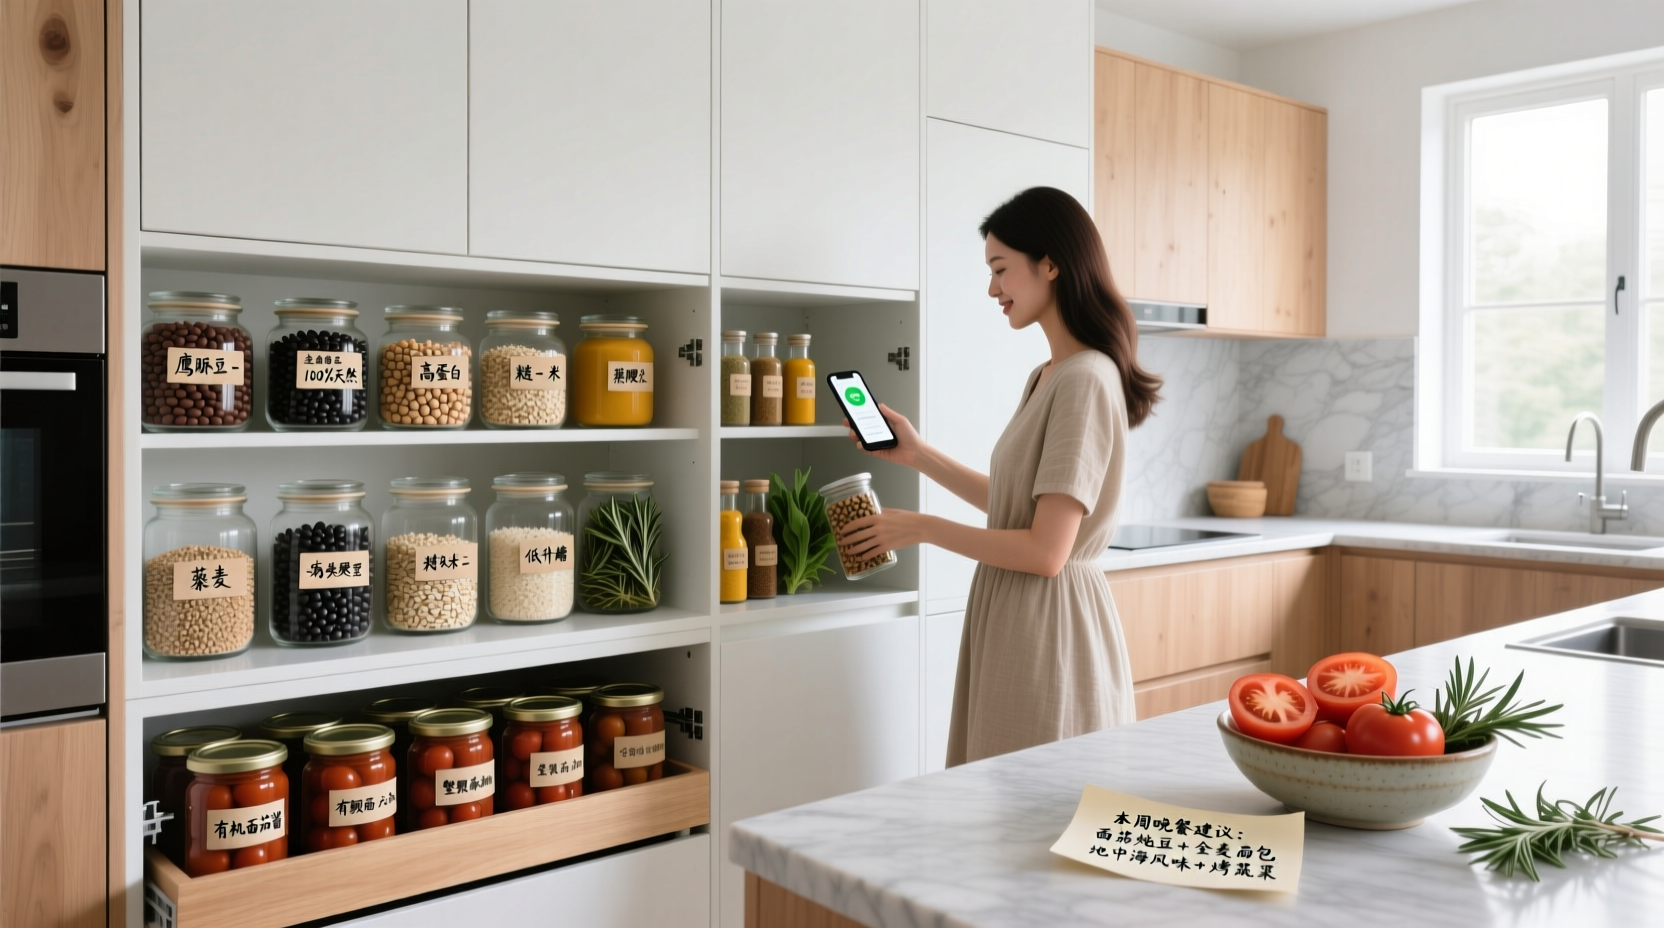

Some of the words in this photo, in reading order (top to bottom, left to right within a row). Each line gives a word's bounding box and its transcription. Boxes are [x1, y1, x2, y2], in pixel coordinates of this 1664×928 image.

[304, 367, 358, 384] 100%天然
[420, 361, 461, 382] 高蛋白
